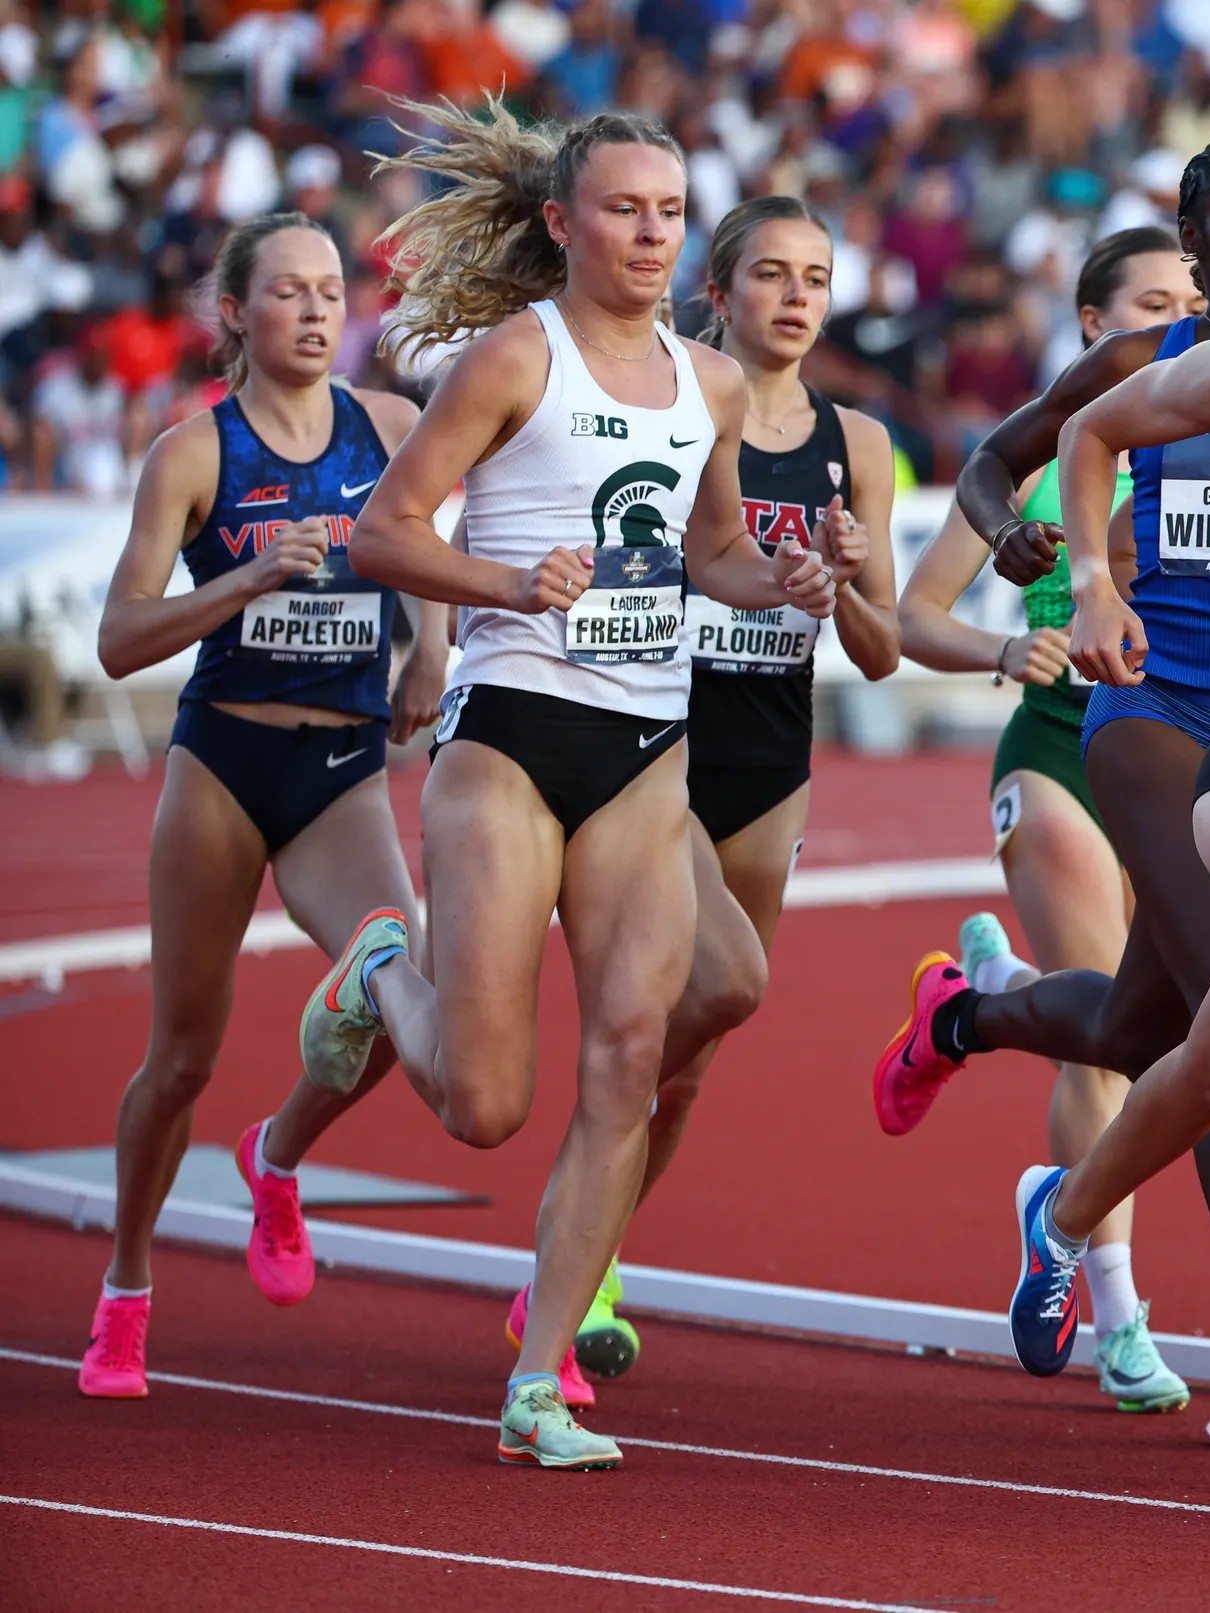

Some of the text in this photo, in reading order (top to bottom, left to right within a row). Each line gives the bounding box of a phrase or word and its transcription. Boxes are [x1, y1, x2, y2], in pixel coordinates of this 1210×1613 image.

[240, 484, 290, 503] ACC
[288, 600, 345, 615] MARGOT
[610, 596, 657, 611] LAUREN
[731, 608, 784, 627] SIMONE
[250, 616, 374, 646] APPLETON
[575, 613, 677, 644] FREELAND
[697, 624, 807, 657] PLOURDE
